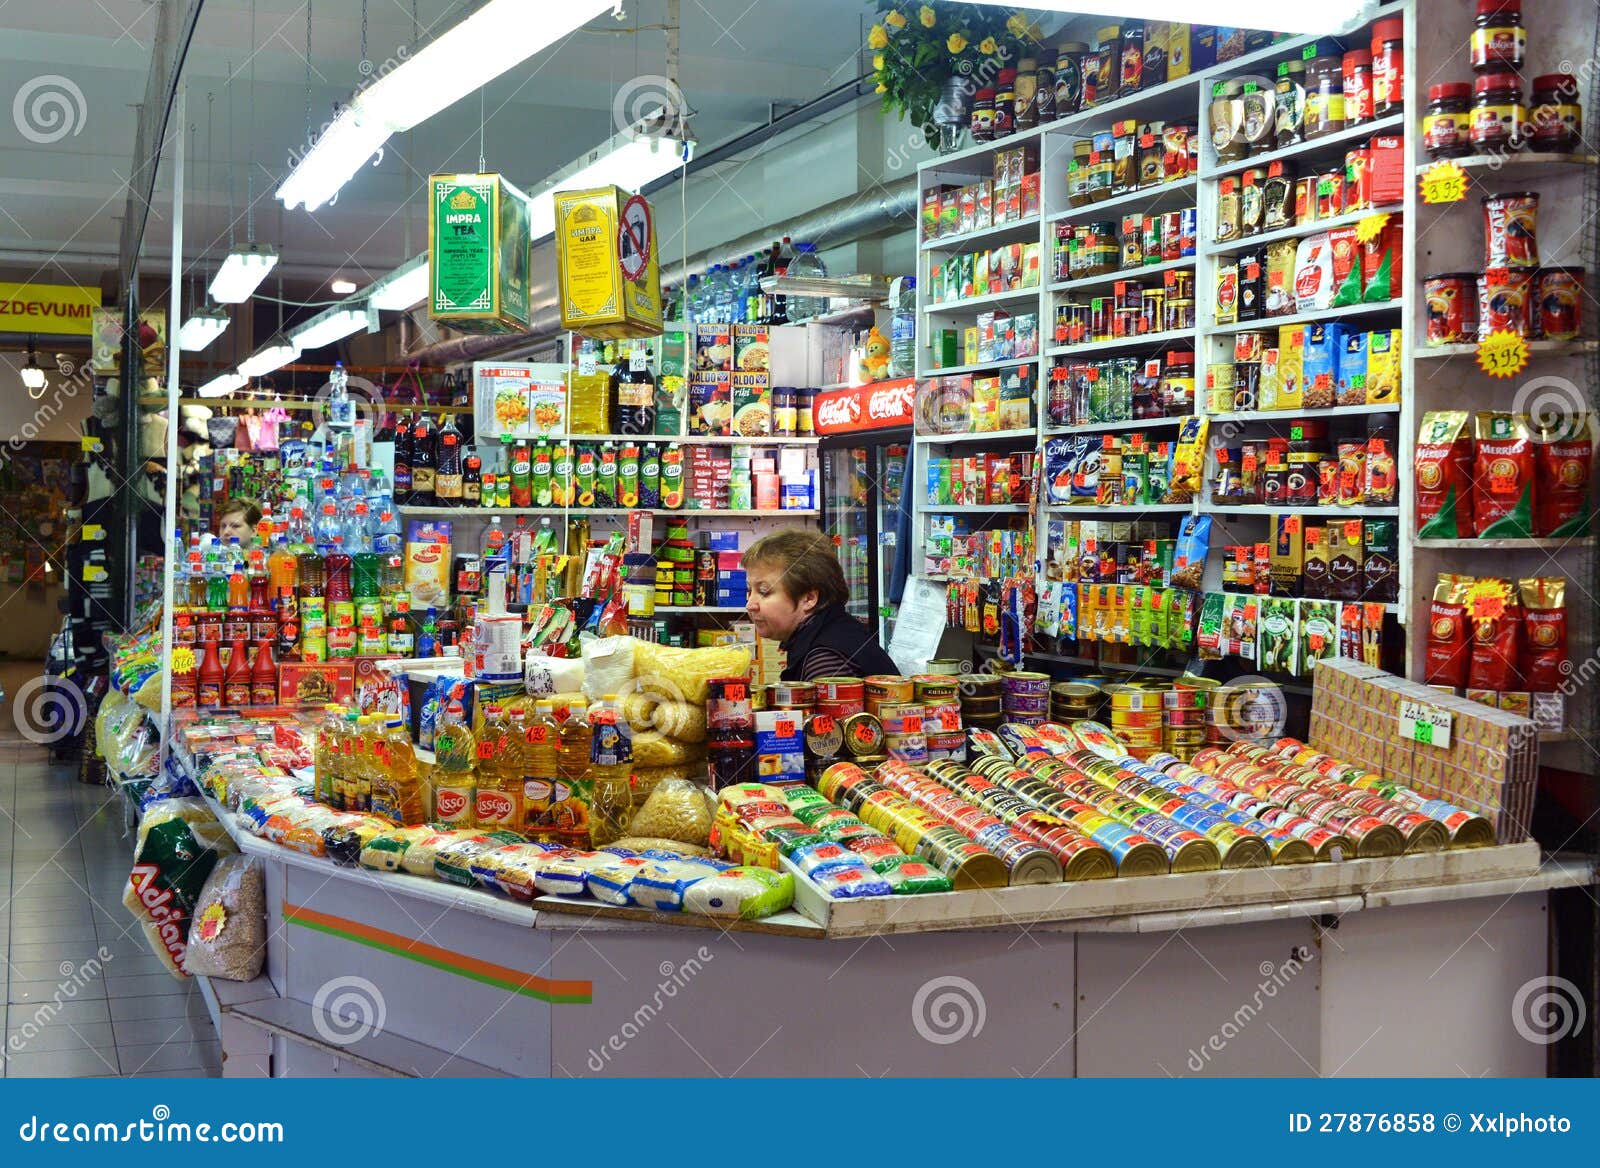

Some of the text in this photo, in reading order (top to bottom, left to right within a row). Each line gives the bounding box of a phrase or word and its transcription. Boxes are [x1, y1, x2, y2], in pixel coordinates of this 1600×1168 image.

[446, 213, 481, 224] IMPRA
[452, 225, 476, 236] TEA
[131, 864, 192, 975] Adrian
